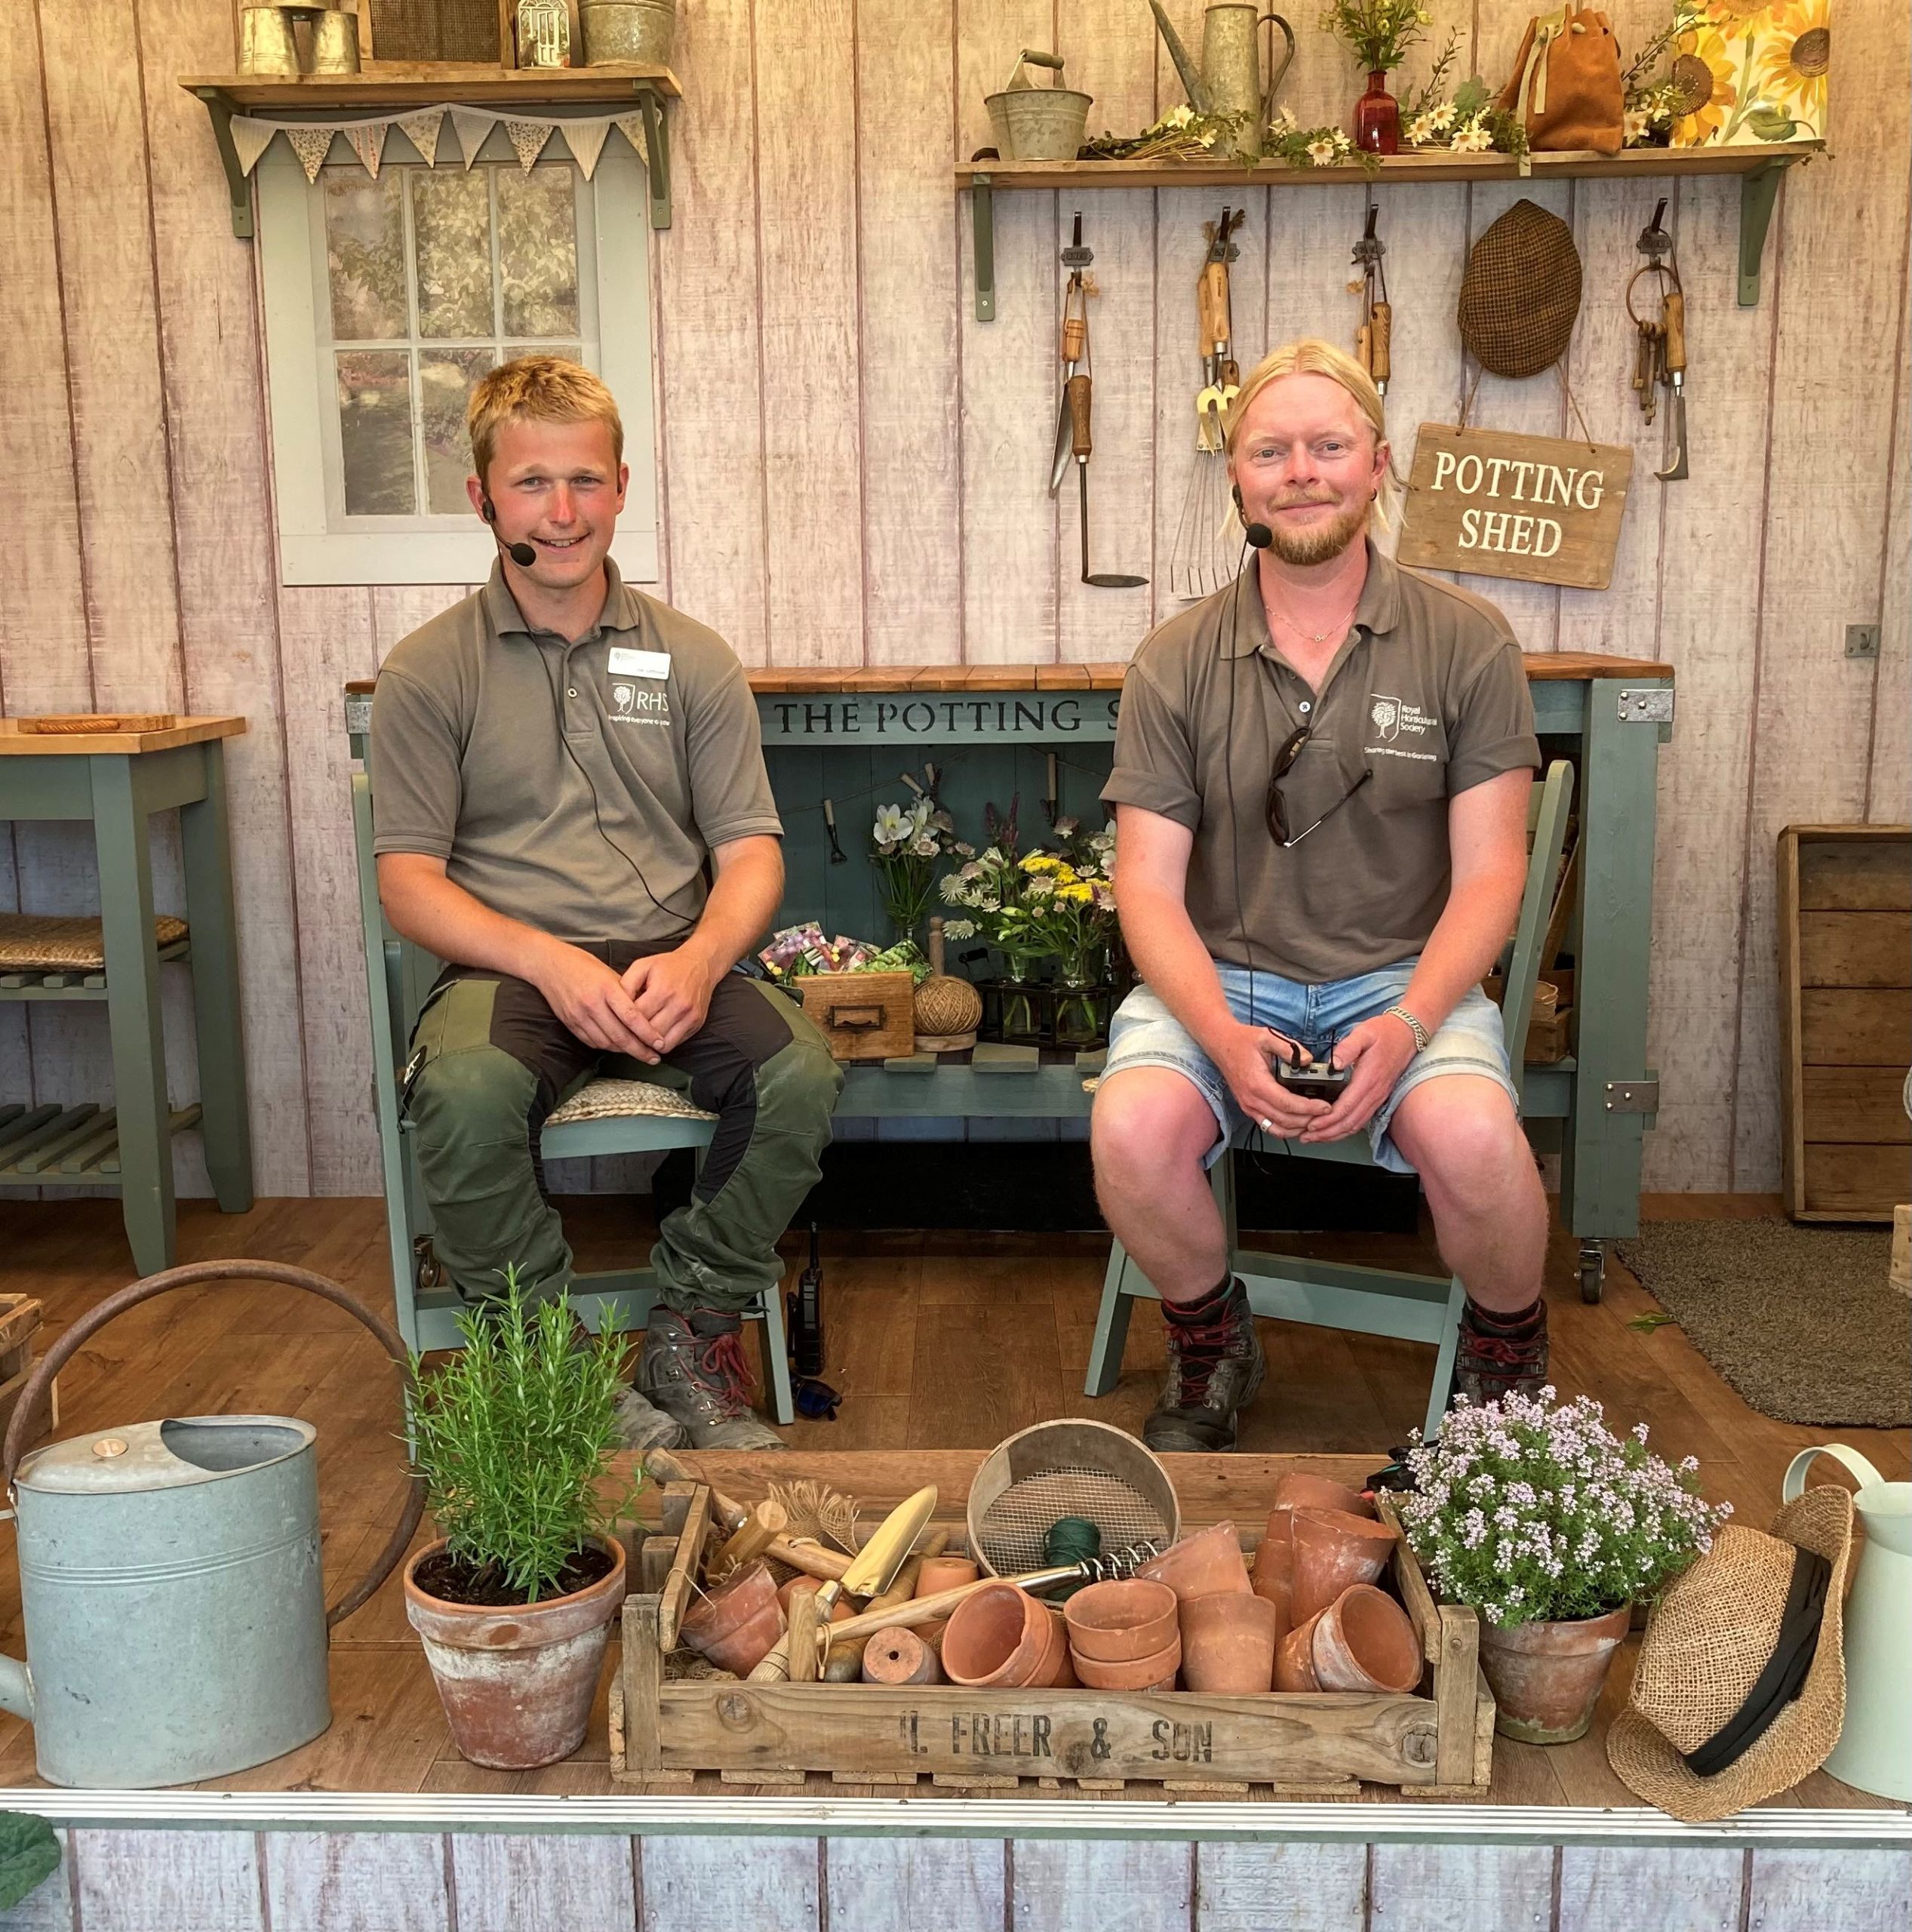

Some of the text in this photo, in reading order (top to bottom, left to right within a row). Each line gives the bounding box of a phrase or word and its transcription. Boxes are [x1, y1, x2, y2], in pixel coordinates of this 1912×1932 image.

[1431, 451, 1605, 510] POTTING
[1458, 509, 1562, 557] SHED
[637, 691, 669, 712] RHS
[774, 703, 860, 734] THE
[877, 700, 1081, 733] POTTING
[952, 1712, 1052, 1758] FREER
[1090, 1717, 1111, 1760] &
